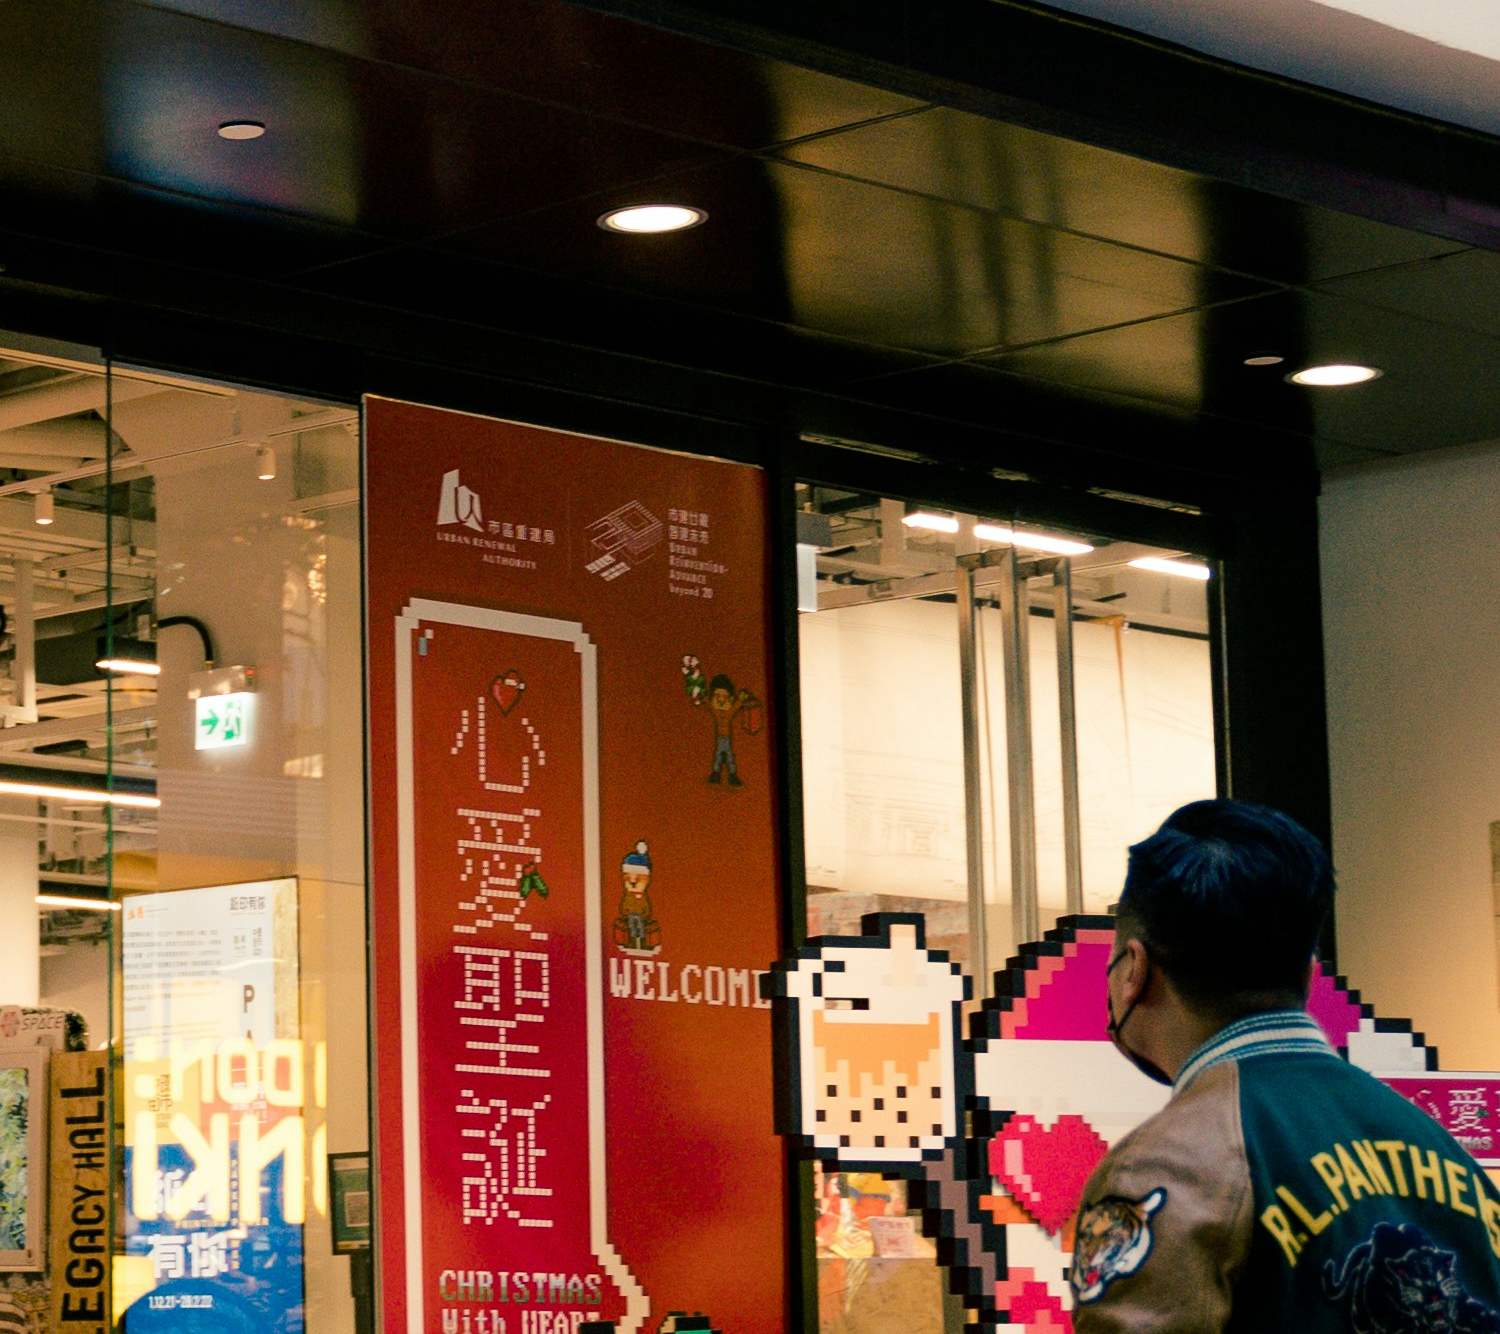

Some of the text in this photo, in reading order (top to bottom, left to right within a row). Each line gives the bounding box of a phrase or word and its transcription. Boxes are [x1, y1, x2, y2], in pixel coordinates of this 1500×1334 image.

[21, 1016, 65, 1031] SPACE
[60, 1067, 105, 1169] HALL
[147, 1232, 229, 1279] 有你
[439, 1269, 602, 1305] CHRISTMAS
